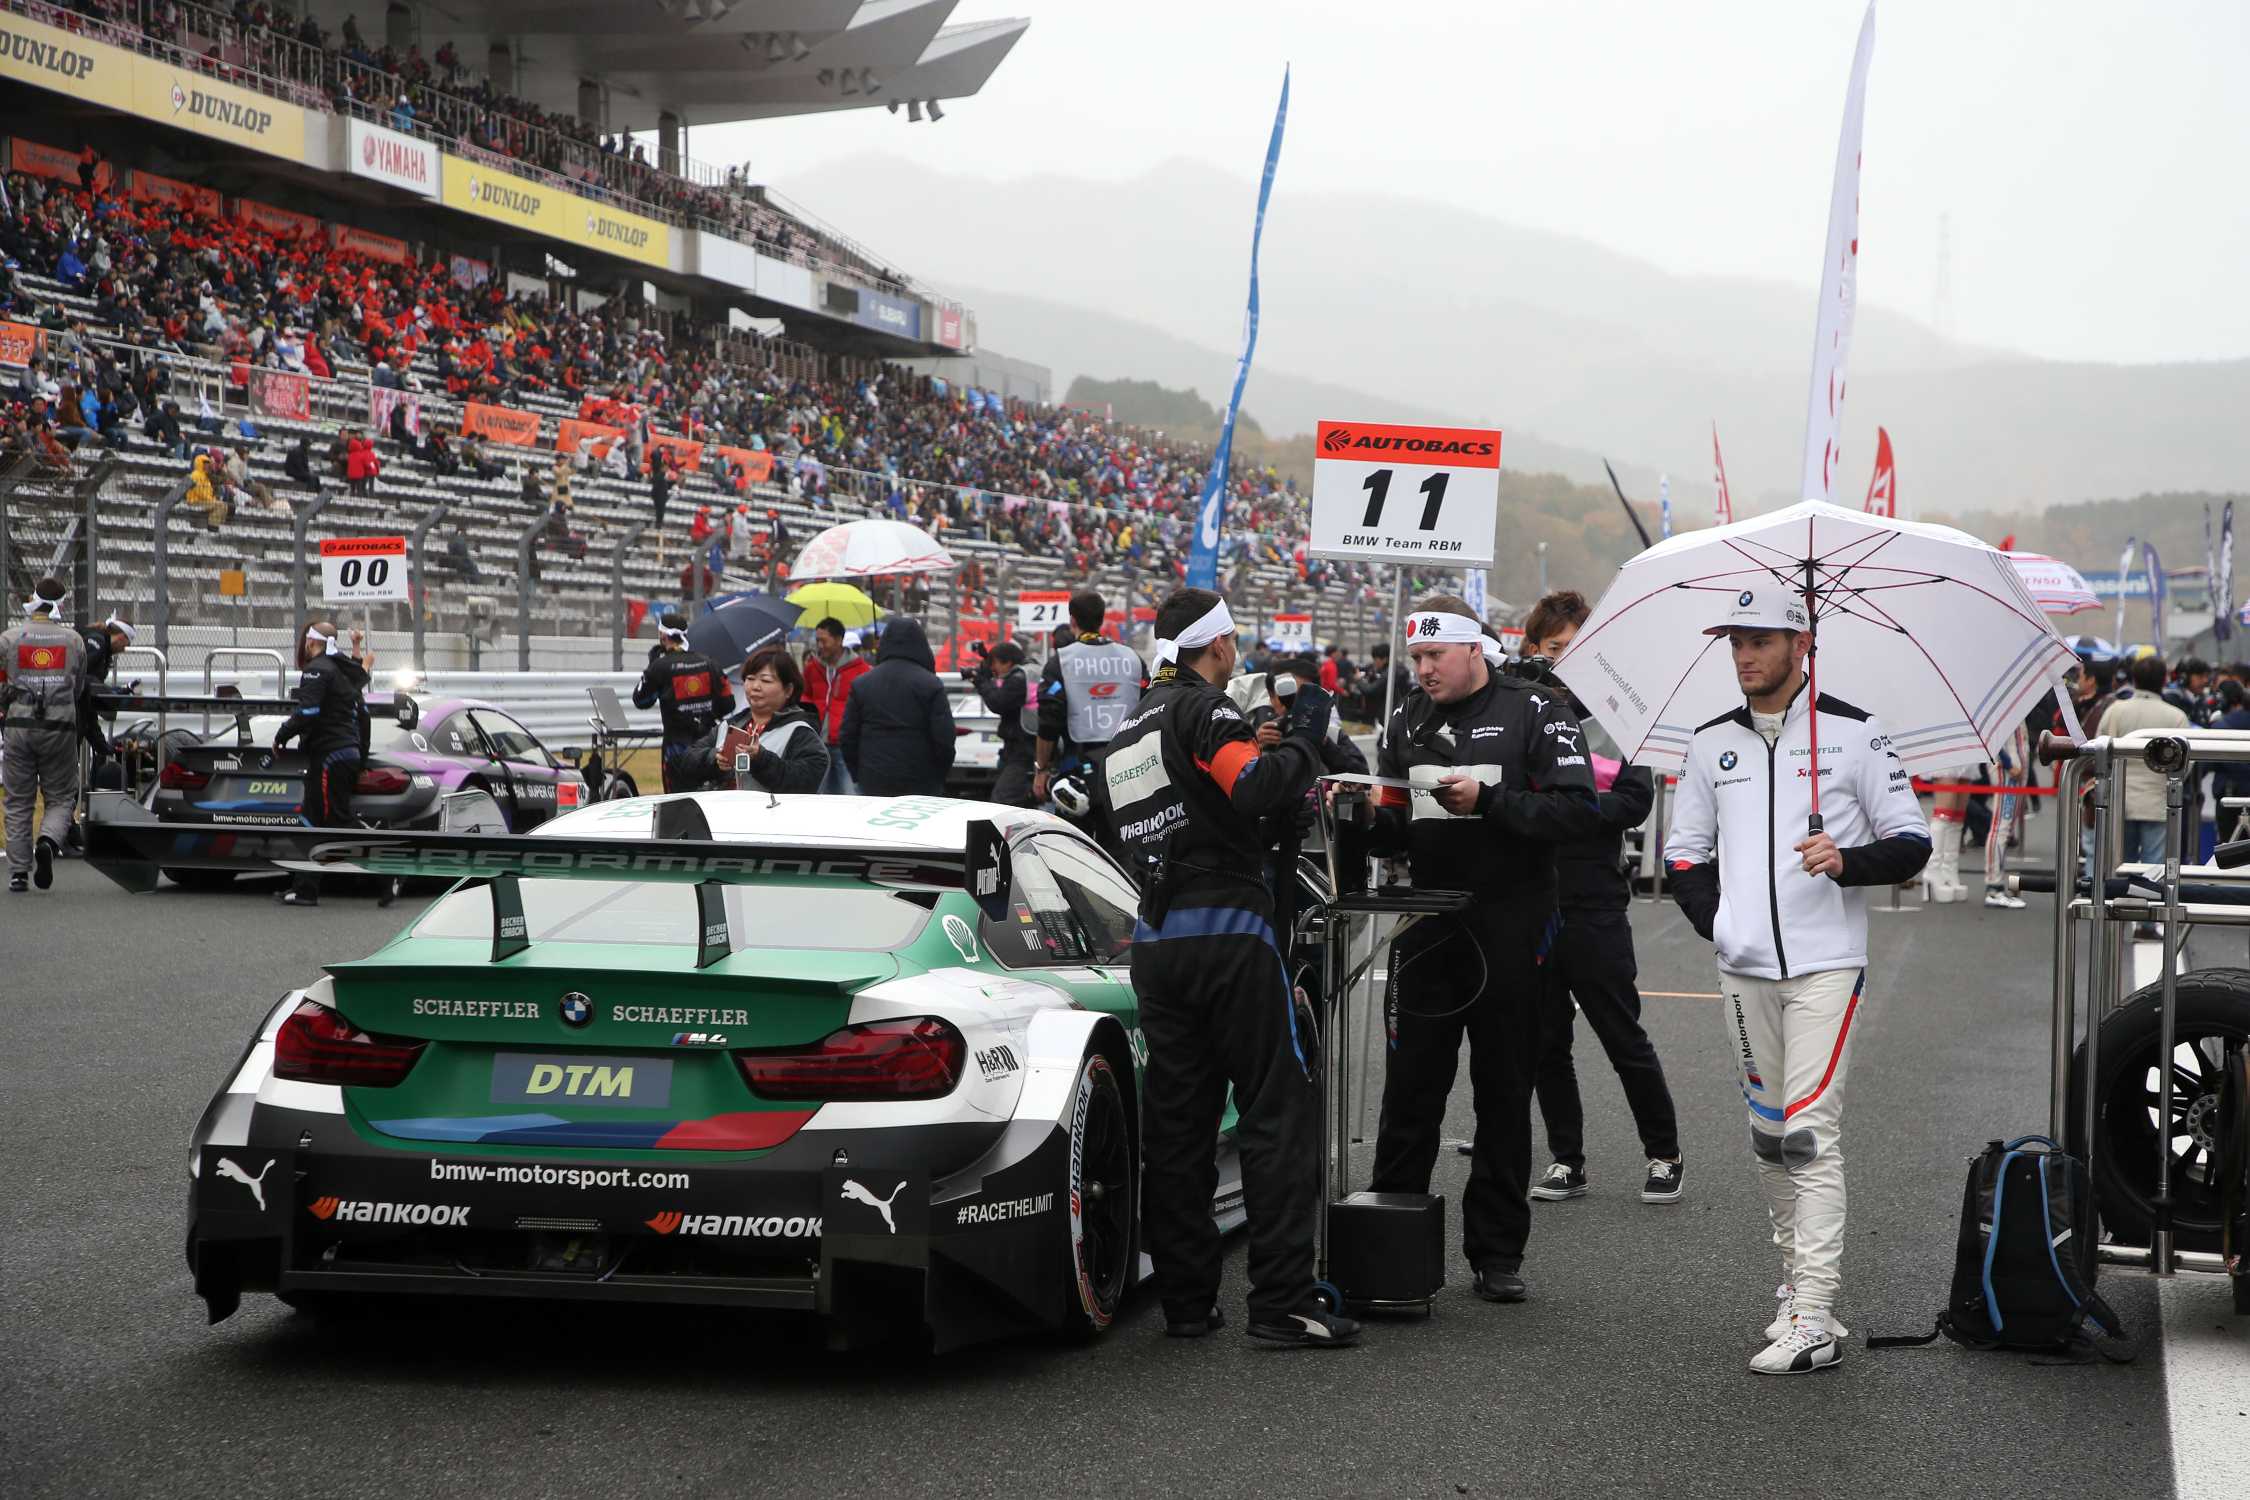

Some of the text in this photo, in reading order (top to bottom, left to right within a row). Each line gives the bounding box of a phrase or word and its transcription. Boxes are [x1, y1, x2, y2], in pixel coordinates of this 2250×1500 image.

[188, 90, 272, 134] DUNLOP
[378, 138, 427, 183] YAMAHA
[482, 182, 541, 216] DUNLOP
[597, 218, 649, 248] DUNLOP
[1353, 435, 1494, 456] AUTOBACS
[338, 542, 401, 552] AUTOBACS
[1342, 534, 1462, 551] BMW Team RBM
[340, 558, 389, 588] 00
[2024, 576, 2061, 585] ENSO
[1032, 604, 1059, 621] 21
[1419, 616, 1441, 637] 勝
[1074, 656, 1132, 676] PHOTO
[1083, 703, 1128, 730] 157
[1790, 746, 1842, 757] SCHAFFLER
[213, 759, 239, 771] PUMA
[1110, 755, 1159, 788] SCHAEFFLER
[248, 781, 288, 794] DTM
[527, 783, 548, 798] SUPER
[547, 785, 556, 798] GT
[1722, 776, 1752, 786] Motorsport
[977, 866, 997, 897] PUMA
[501, 915, 525, 928] BECKER
[706, 922, 727, 936] BECKER
[1021, 929, 1042, 952] WIT
[413, 998, 540, 1019] SCHAEFFLER
[613, 1005, 749, 1026] SCHAEFFLER
[1732, 993, 1754, 1059] Motorsport
[688, 1033, 728, 1046] M4
[526, 1064, 634, 1098] DTM
[430, 1159, 690, 1190] bmw-motorsport.com
[957, 1192, 1054, 1224] #RACETHELIMIT
[1801, 1315, 1825, 1323] MARCO
